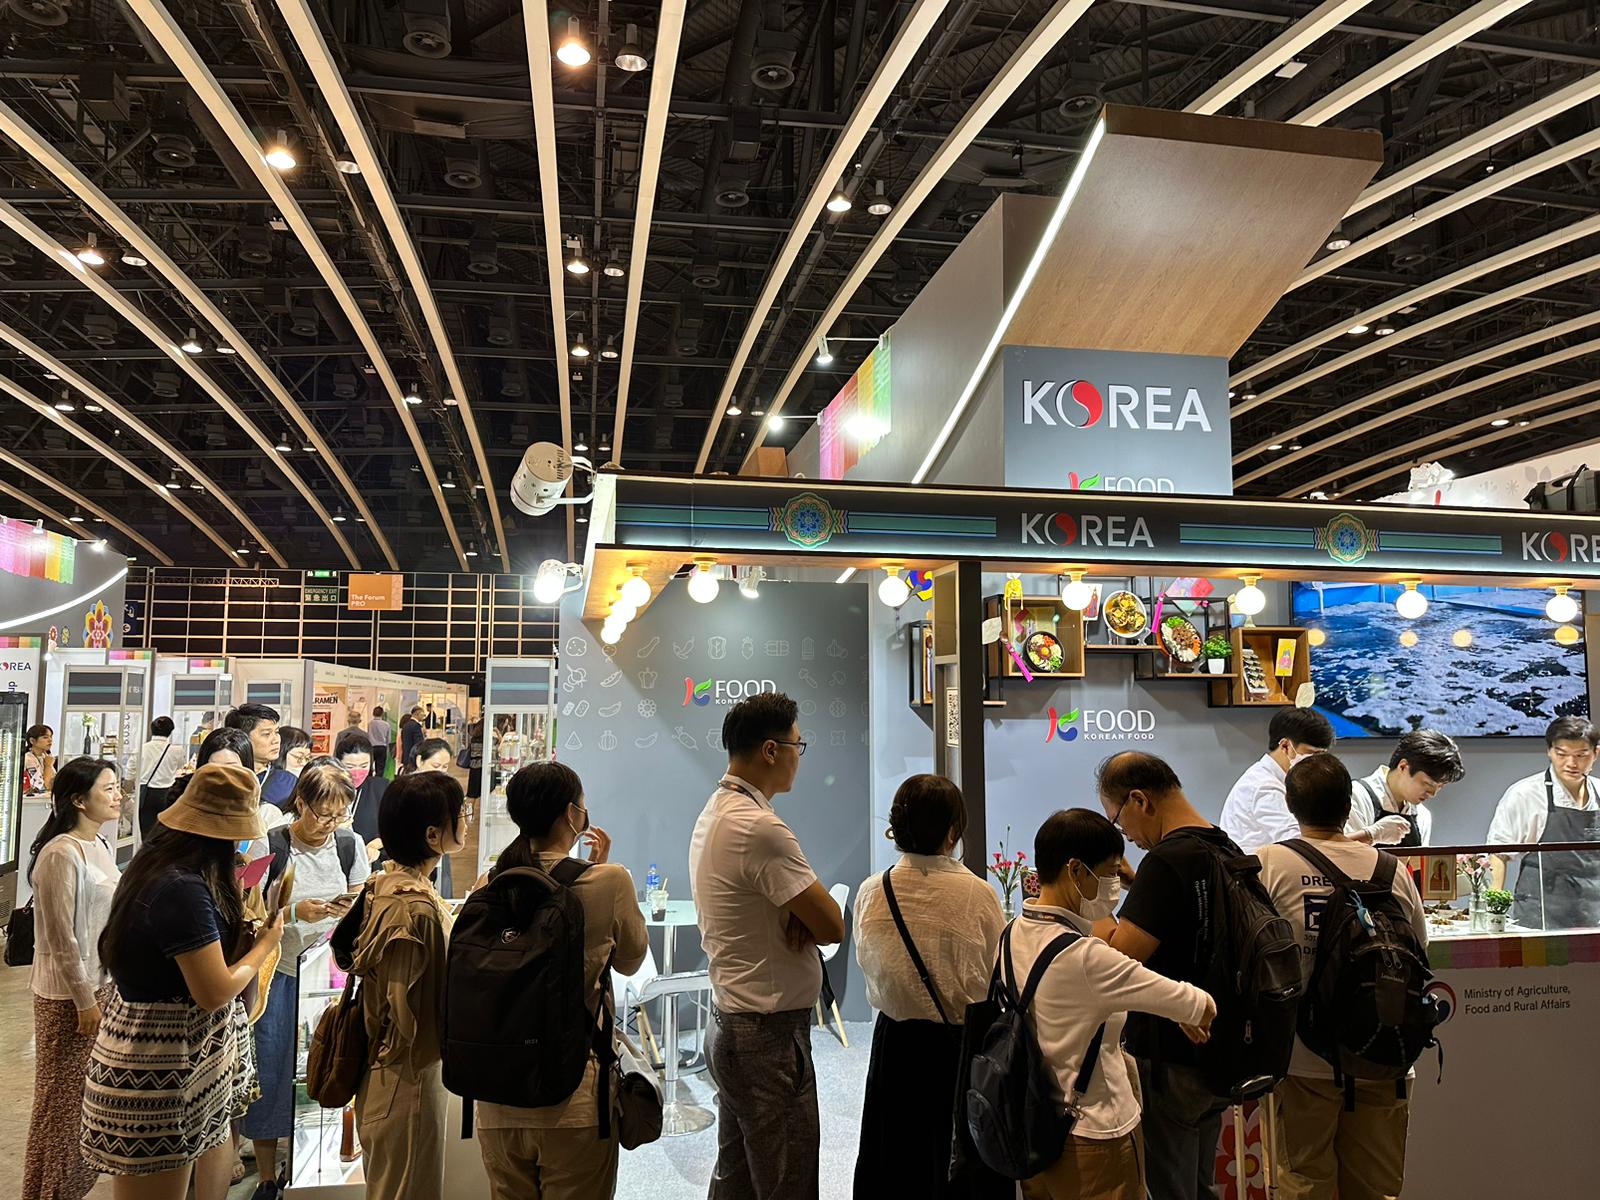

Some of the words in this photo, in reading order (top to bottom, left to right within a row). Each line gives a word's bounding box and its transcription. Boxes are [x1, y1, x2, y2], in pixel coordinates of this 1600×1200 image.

[1022, 379, 1212, 431] KOREA
[1020, 511, 1154, 548] KOREA
[0, 662, 31, 671] OREA
[715, 679, 776, 699] FOOD
[1083, 709, 1156, 732] FOOD
[1464, 989, 1502, 999] Ministry
[1504, 986, 1514, 997] of
[1517, 985, 1570, 998] Agriculture,
[1465, 1004, 1490, 1014] Food
[1492, 1002, 1511, 1013] and
[1513, 1001, 1538, 1011] Rural
[1541, 999, 1570, 1010] Affairs
